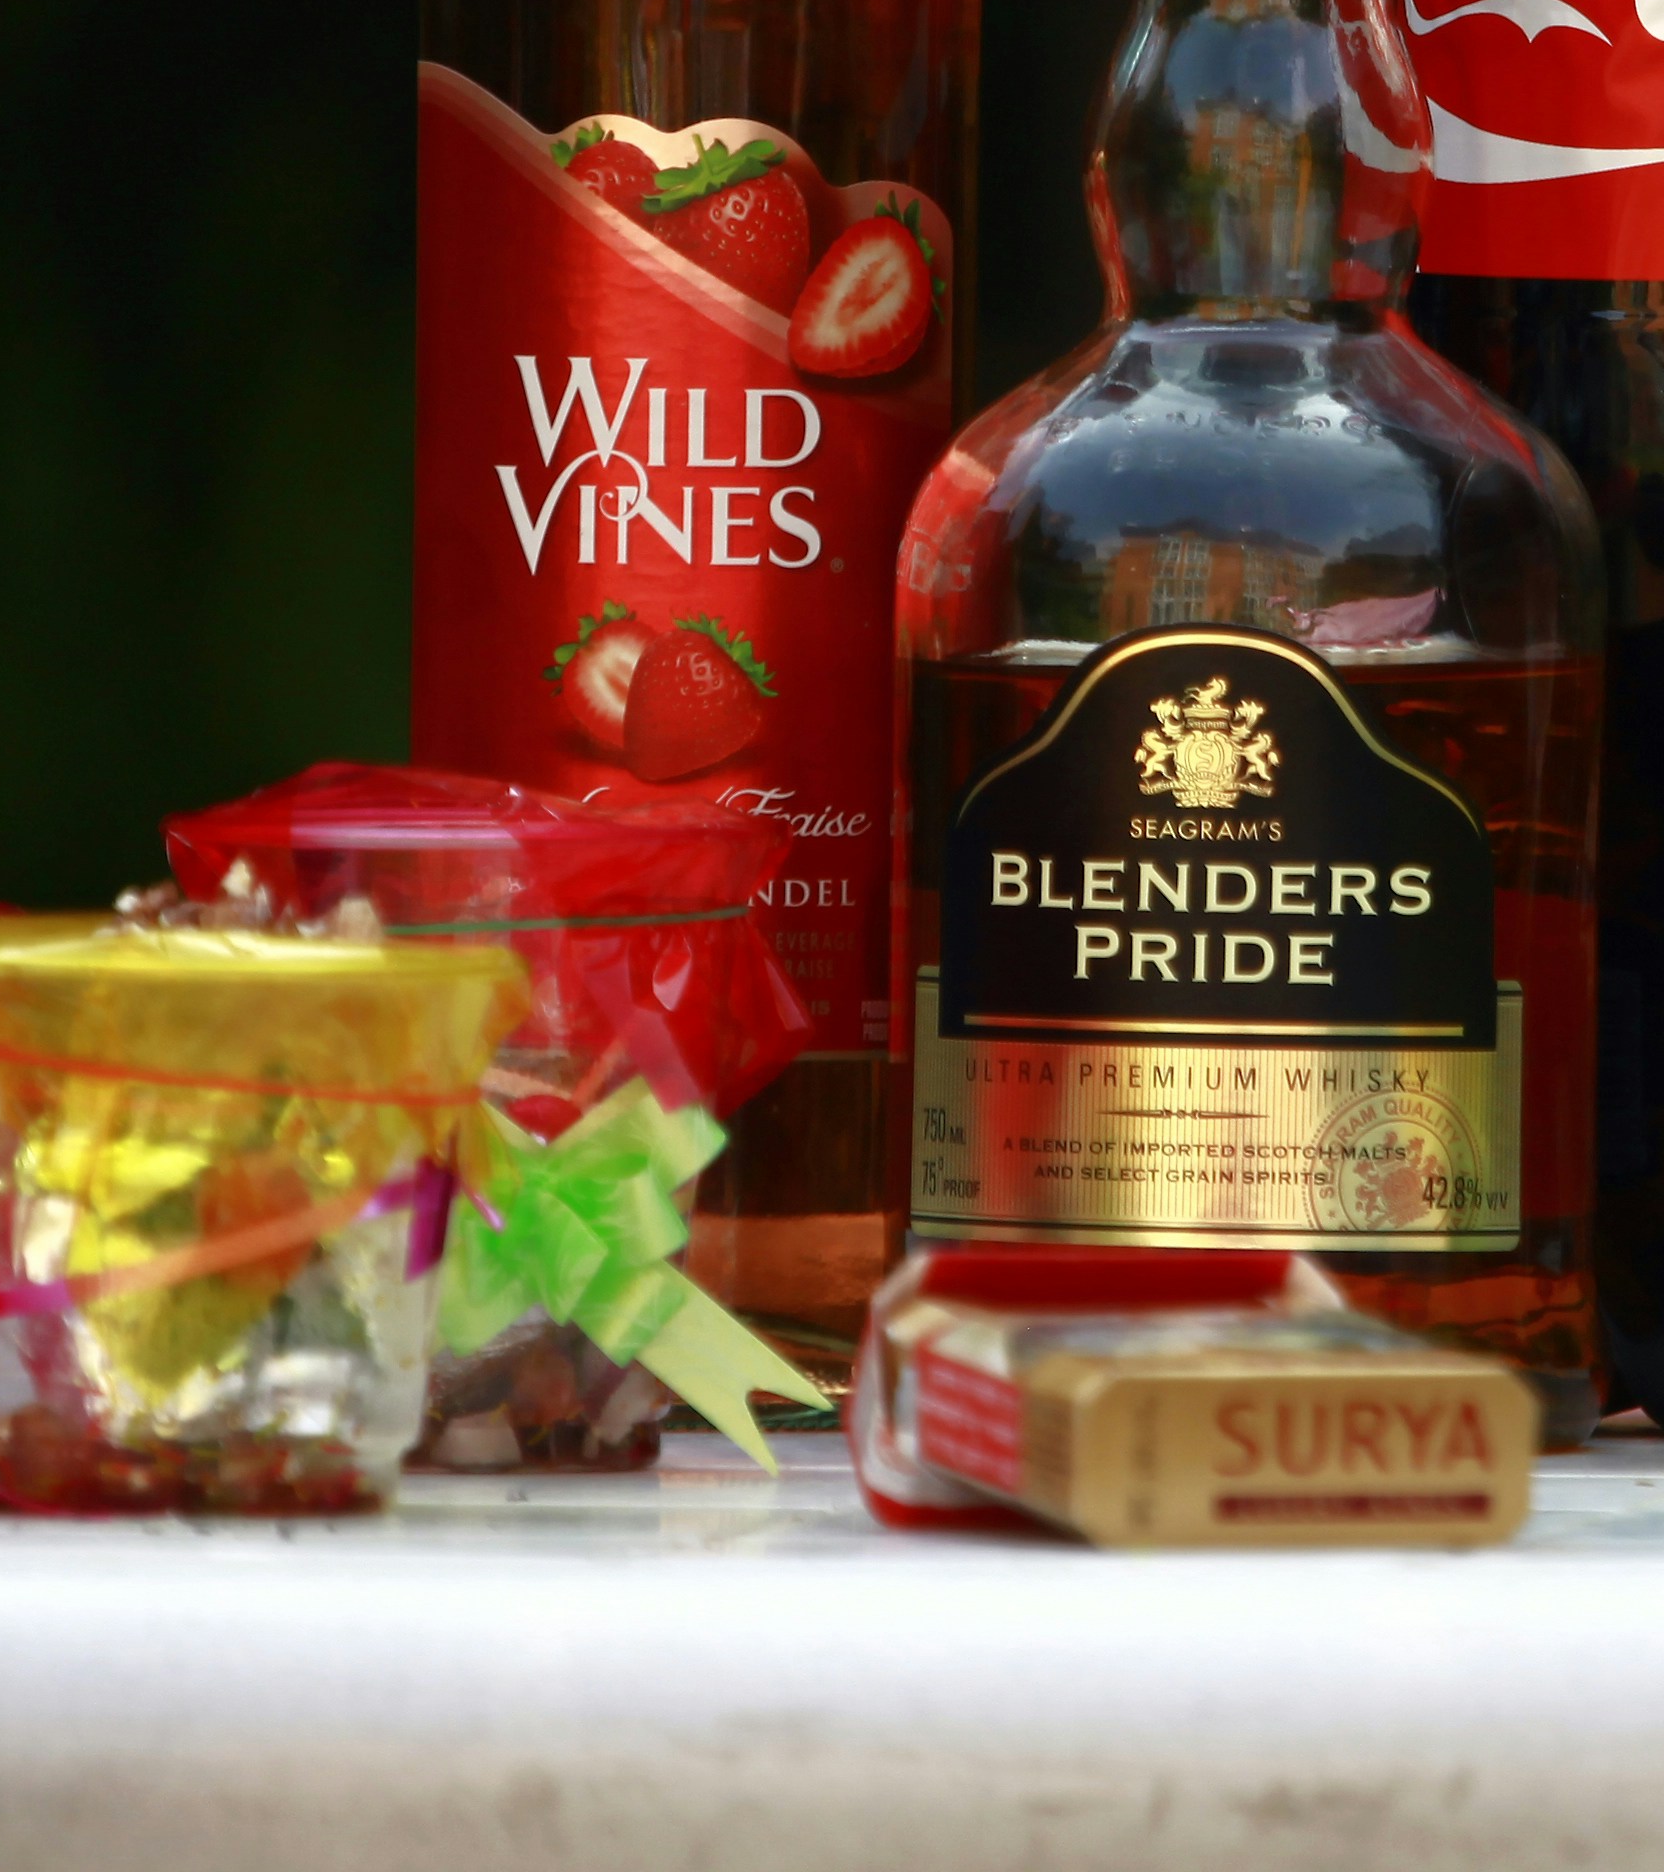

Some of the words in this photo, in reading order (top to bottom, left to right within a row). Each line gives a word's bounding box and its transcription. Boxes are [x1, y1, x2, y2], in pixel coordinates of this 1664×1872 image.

[513, 355, 823, 468] WILD
[494, 449, 823, 576] VINES
[1129, 818, 1282, 842] SEAGRAM'S
[747, 879, 856, 908] NDEL
[989, 852, 1433, 917] BLENDERS
[1074, 924, 1335, 986] PRIDE
[965, 1058, 1055, 1086] ULTRA
[1079, 1063, 1257, 1091] PREMIUM
[1284, 1067, 1430, 1093] WHISKY
[924, 1107, 946, 1143] 750
[1383, 1099, 1462, 1145] QUALITY
[1002, 1137, 1013, 1151] A
[1019, 1138, 1082, 1154] BLEND
[1089, 1141, 1116, 1155] OF
[1123, 1142, 1235, 1159] IMPORTED
[1243, 1145, 1332, 1160] SCOTCH
[1339, 1147, 1407, 1161] MALTS
[943, 1180, 981, 1199] PROOF
[1035, 1165, 1074, 1179] AND
[1081, 1167, 1160, 1182] SELECT
[1166, 1169, 1234, 1184] GRAIN
[1243, 1171, 1326, 1186] SPIRITS
[1422, 1176, 1482, 1210] 42.8%
[1213, 1400, 1494, 1478] SURYA
